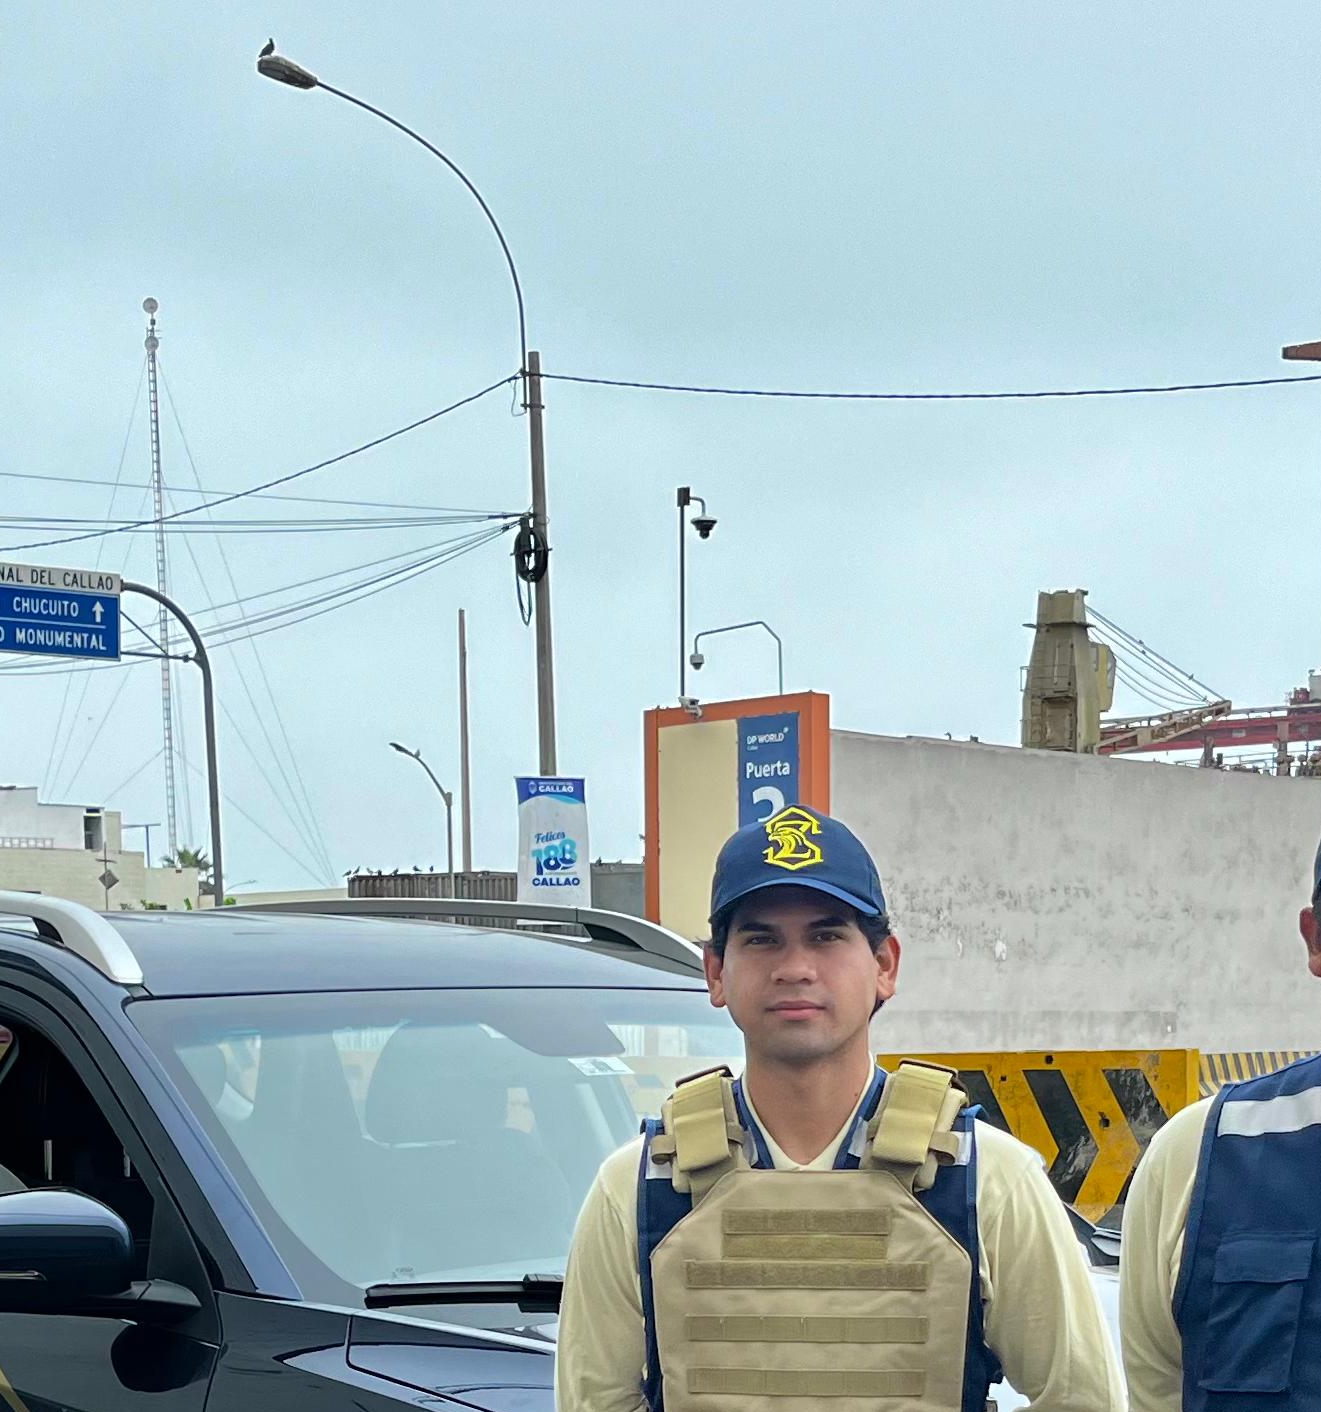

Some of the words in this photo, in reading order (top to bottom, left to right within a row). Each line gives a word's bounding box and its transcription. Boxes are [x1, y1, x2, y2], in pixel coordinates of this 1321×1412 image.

[31, 568, 55, 586] DEL
[63, 572, 114, 591] CALLAO
[13, 596, 79, 617] CHUCUITO
[15, 627, 107, 651] MONUMENTAL
[758, 732, 785, 744] WORLD
[746, 760, 790, 779] Puerta
[538, 785, 574, 793] CALLAO
[532, 877, 580, 887] CALLAO
